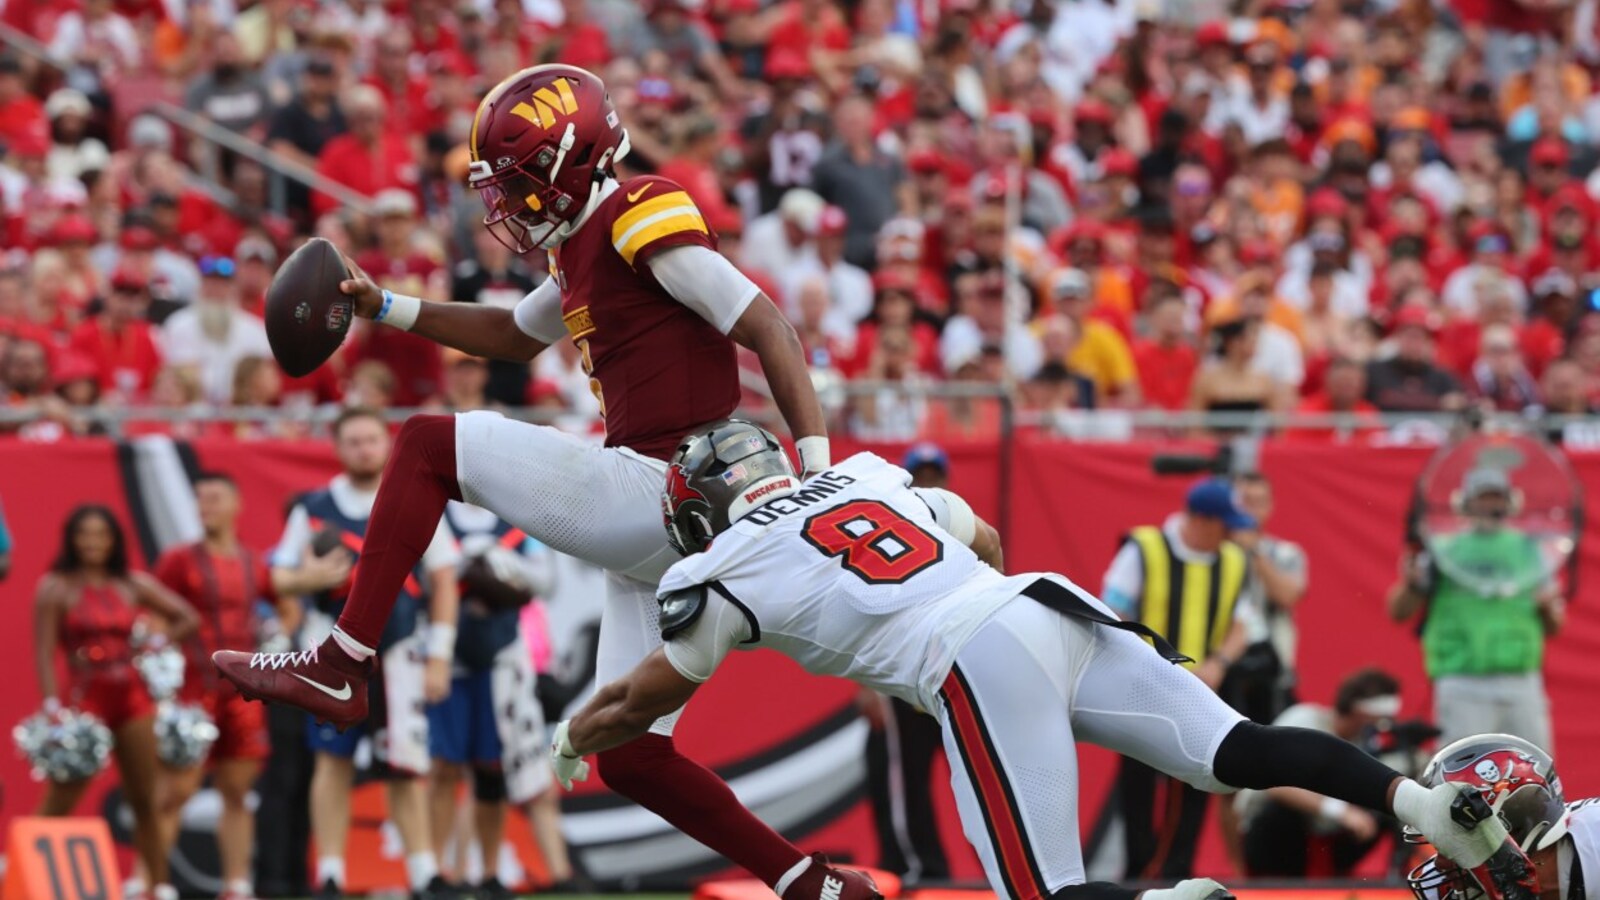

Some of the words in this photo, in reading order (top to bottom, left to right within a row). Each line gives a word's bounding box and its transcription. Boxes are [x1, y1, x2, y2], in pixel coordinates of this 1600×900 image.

[743, 470, 857, 526] DENNIS
[799, 498, 944, 585] 8
[34, 836, 108, 900] 10
